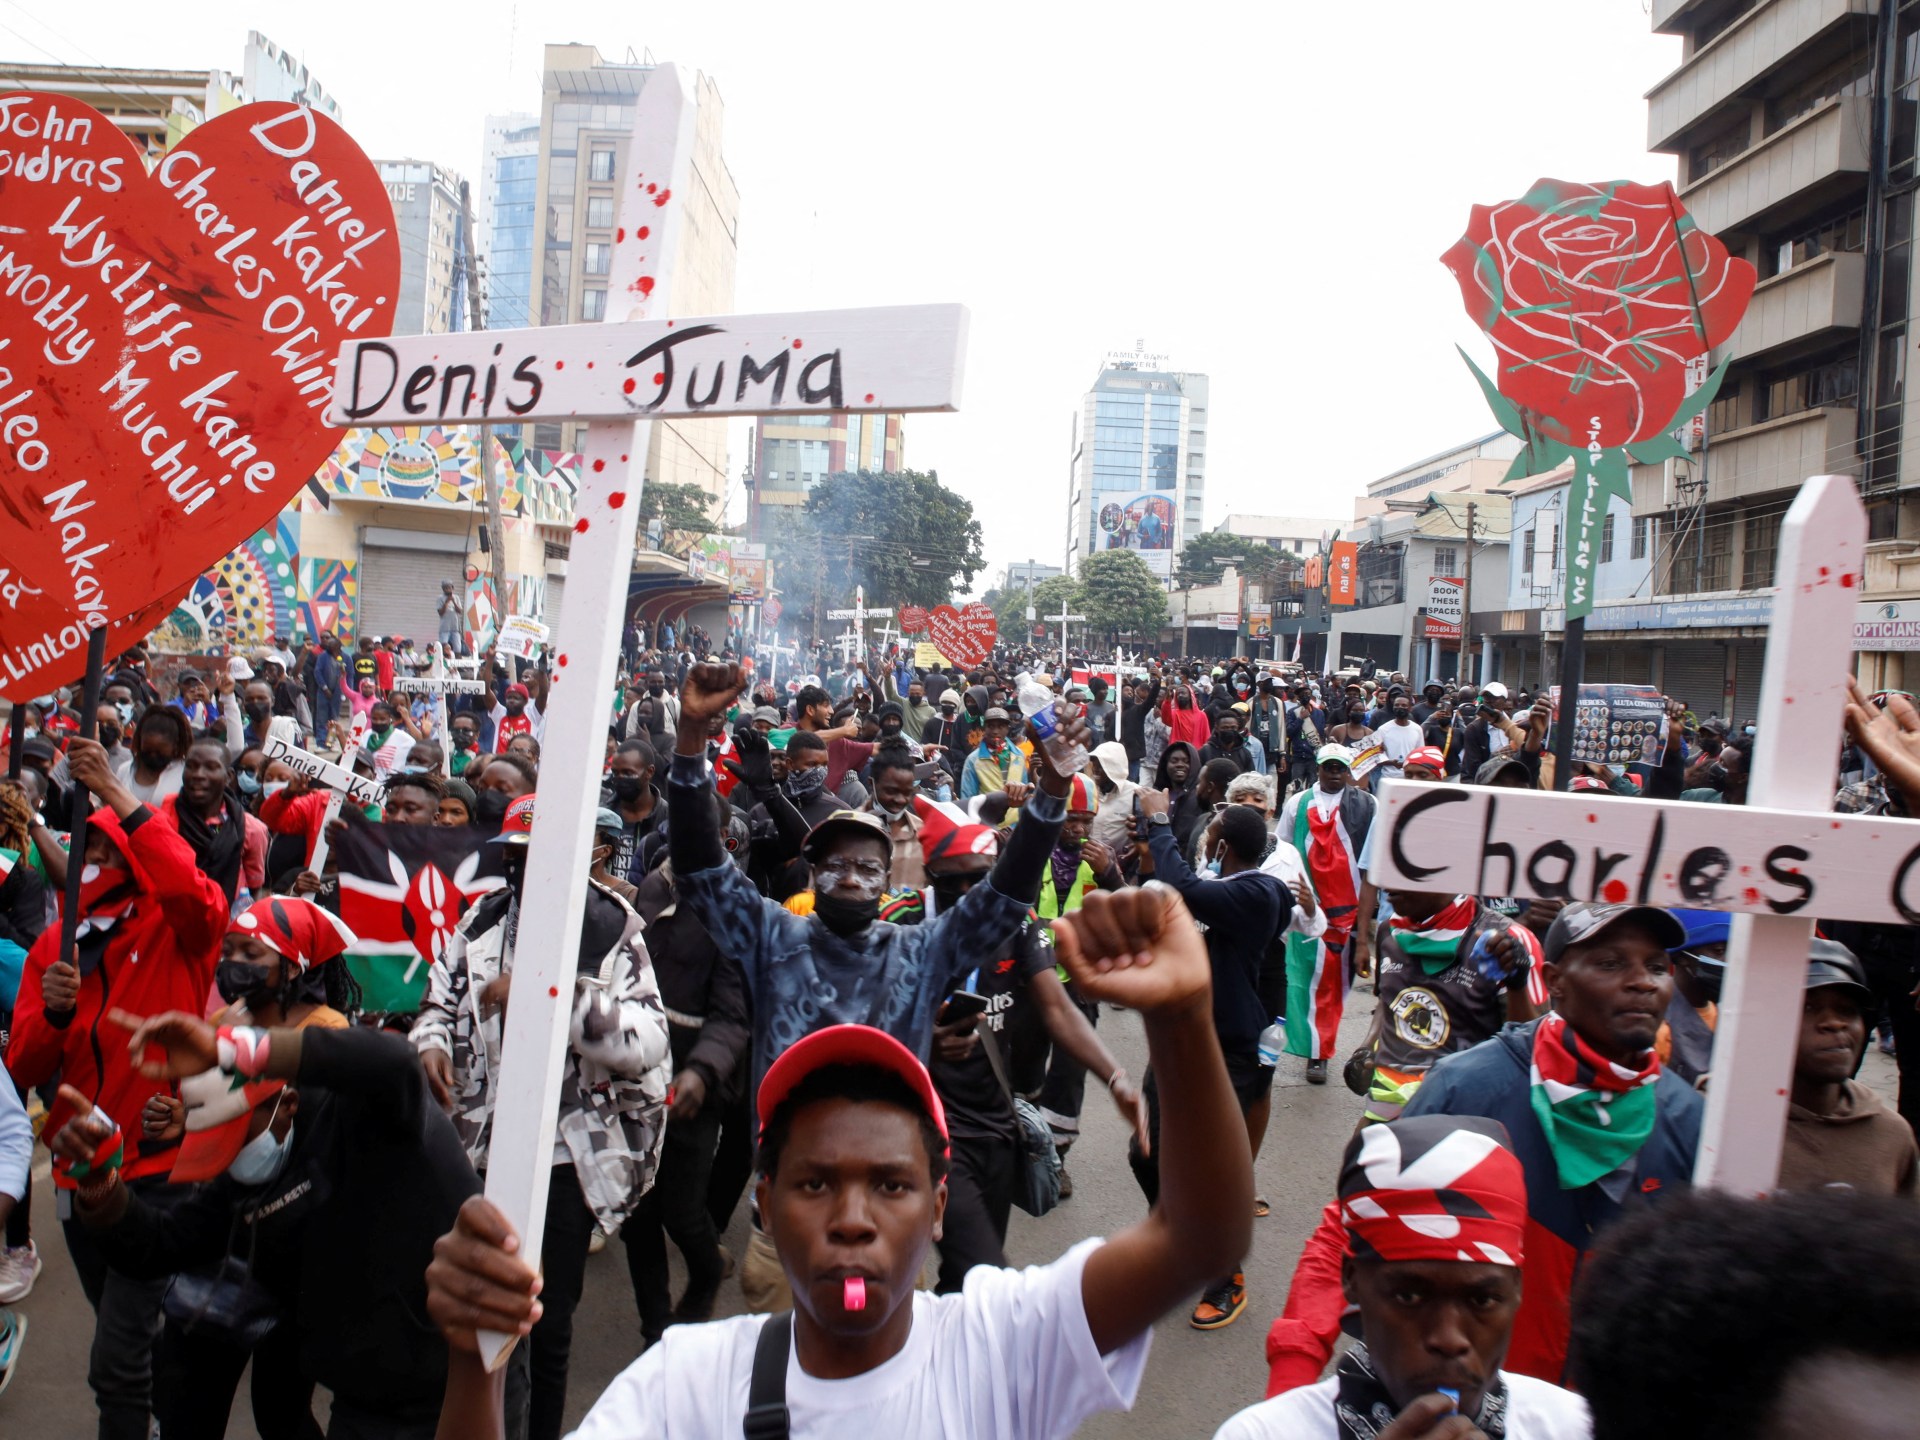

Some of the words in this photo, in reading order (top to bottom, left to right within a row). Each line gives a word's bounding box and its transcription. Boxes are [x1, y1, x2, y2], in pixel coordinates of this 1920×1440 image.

[159, 150, 275, 299] Charles
[272, 216, 386, 332] Kakai
[1107, 351, 1140, 360] FAMILY
[1143, 353, 1169, 361] BANK
[343, 341, 543, 419] Denis
[622, 324, 844, 413] Juma
[1586, 416, 1603, 467] STOP
[1575, 473, 1599, 569] KILLING
[1337, 556, 1351, 593] naivas
[1431, 597, 1460, 606] THESE
[1433, 587, 1459, 596] BOOK
[1572, 576, 1586, 604] US
[1427, 606, 1462, 616] SPACES
[1724, 614, 1758, 624] Graduation
[1425, 624, 1439, 633] 0725
[1854, 622, 1920, 637] OPTICIANS
[1853, 639, 1886, 648] PARADISE
[269, 741, 327, 780] Daniel
[1390, 788, 1816, 914] Charles
[1394, 994, 1440, 1018] TUSKER
